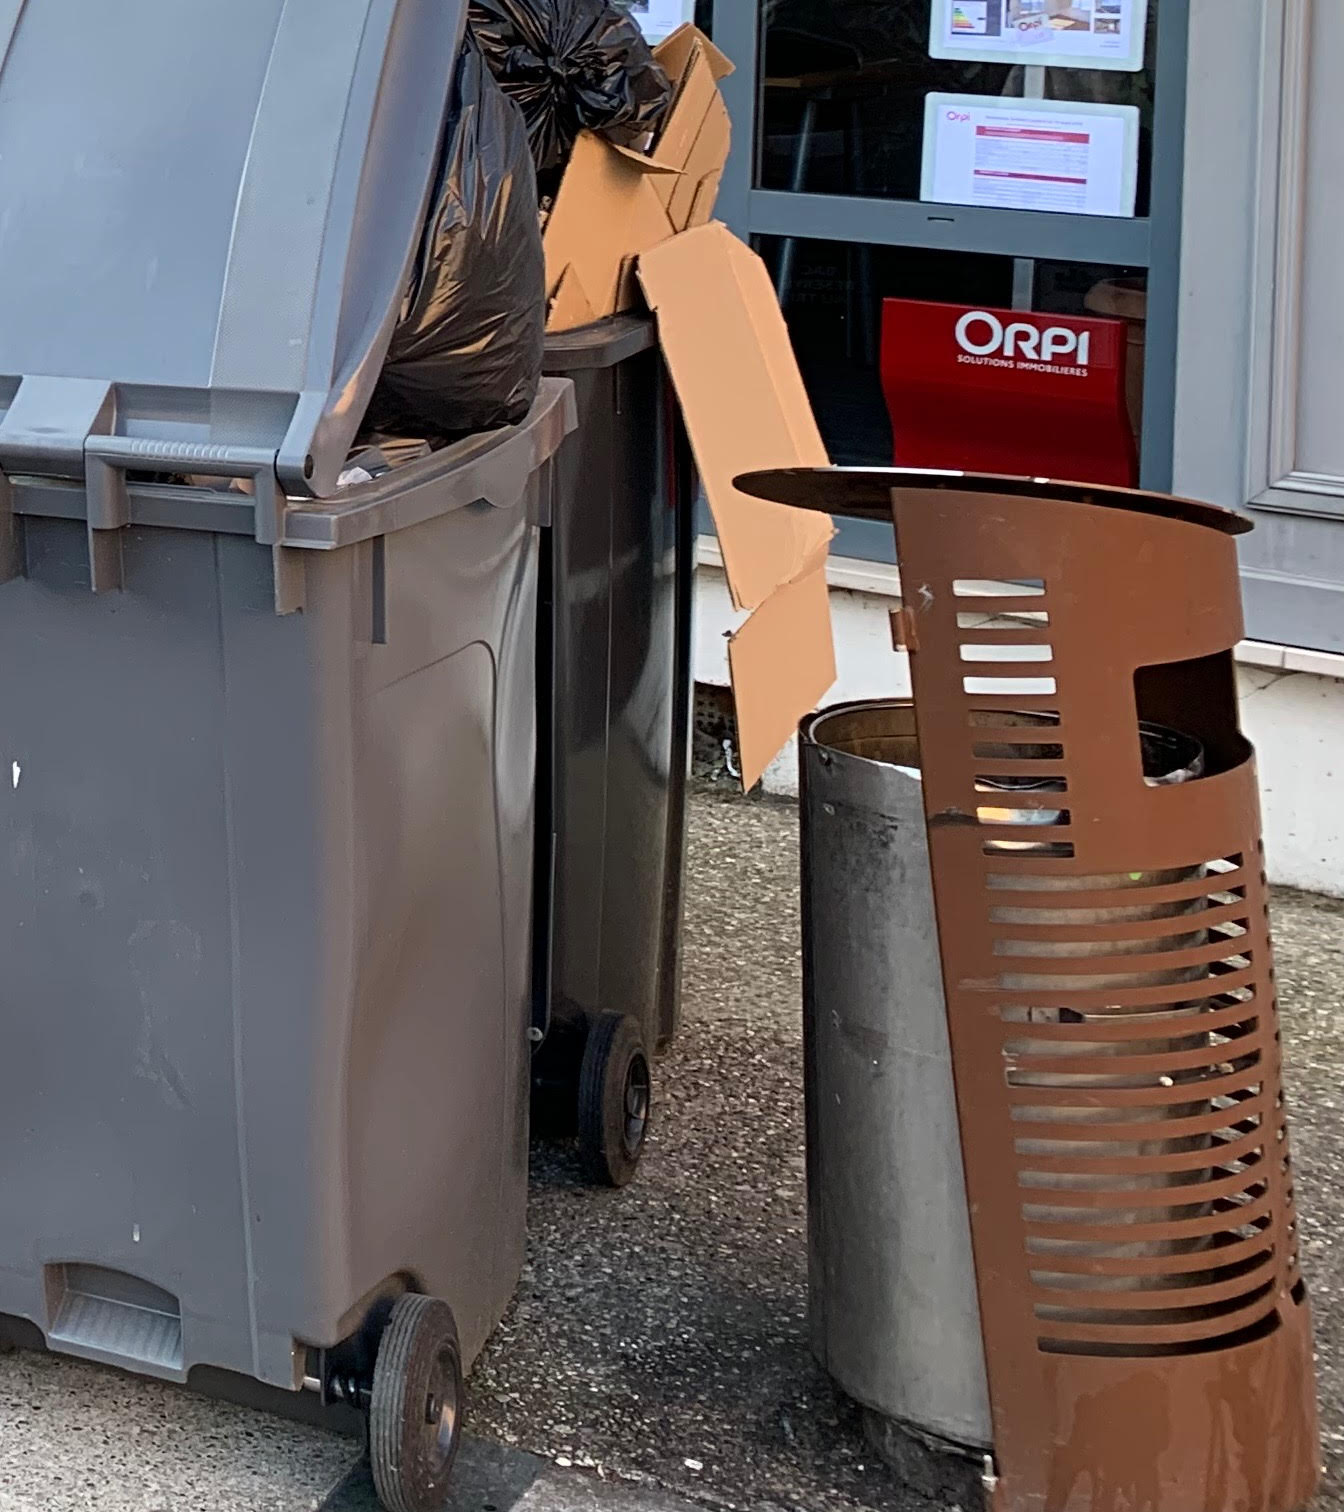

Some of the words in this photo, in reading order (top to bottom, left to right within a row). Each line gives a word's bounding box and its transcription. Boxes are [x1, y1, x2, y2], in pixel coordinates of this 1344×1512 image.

[954, 310, 1090, 366] ORPI
[957, 354, 1015, 369] SOLUTIONS
[1016, 361, 1088, 377] IMMOBILIERES
